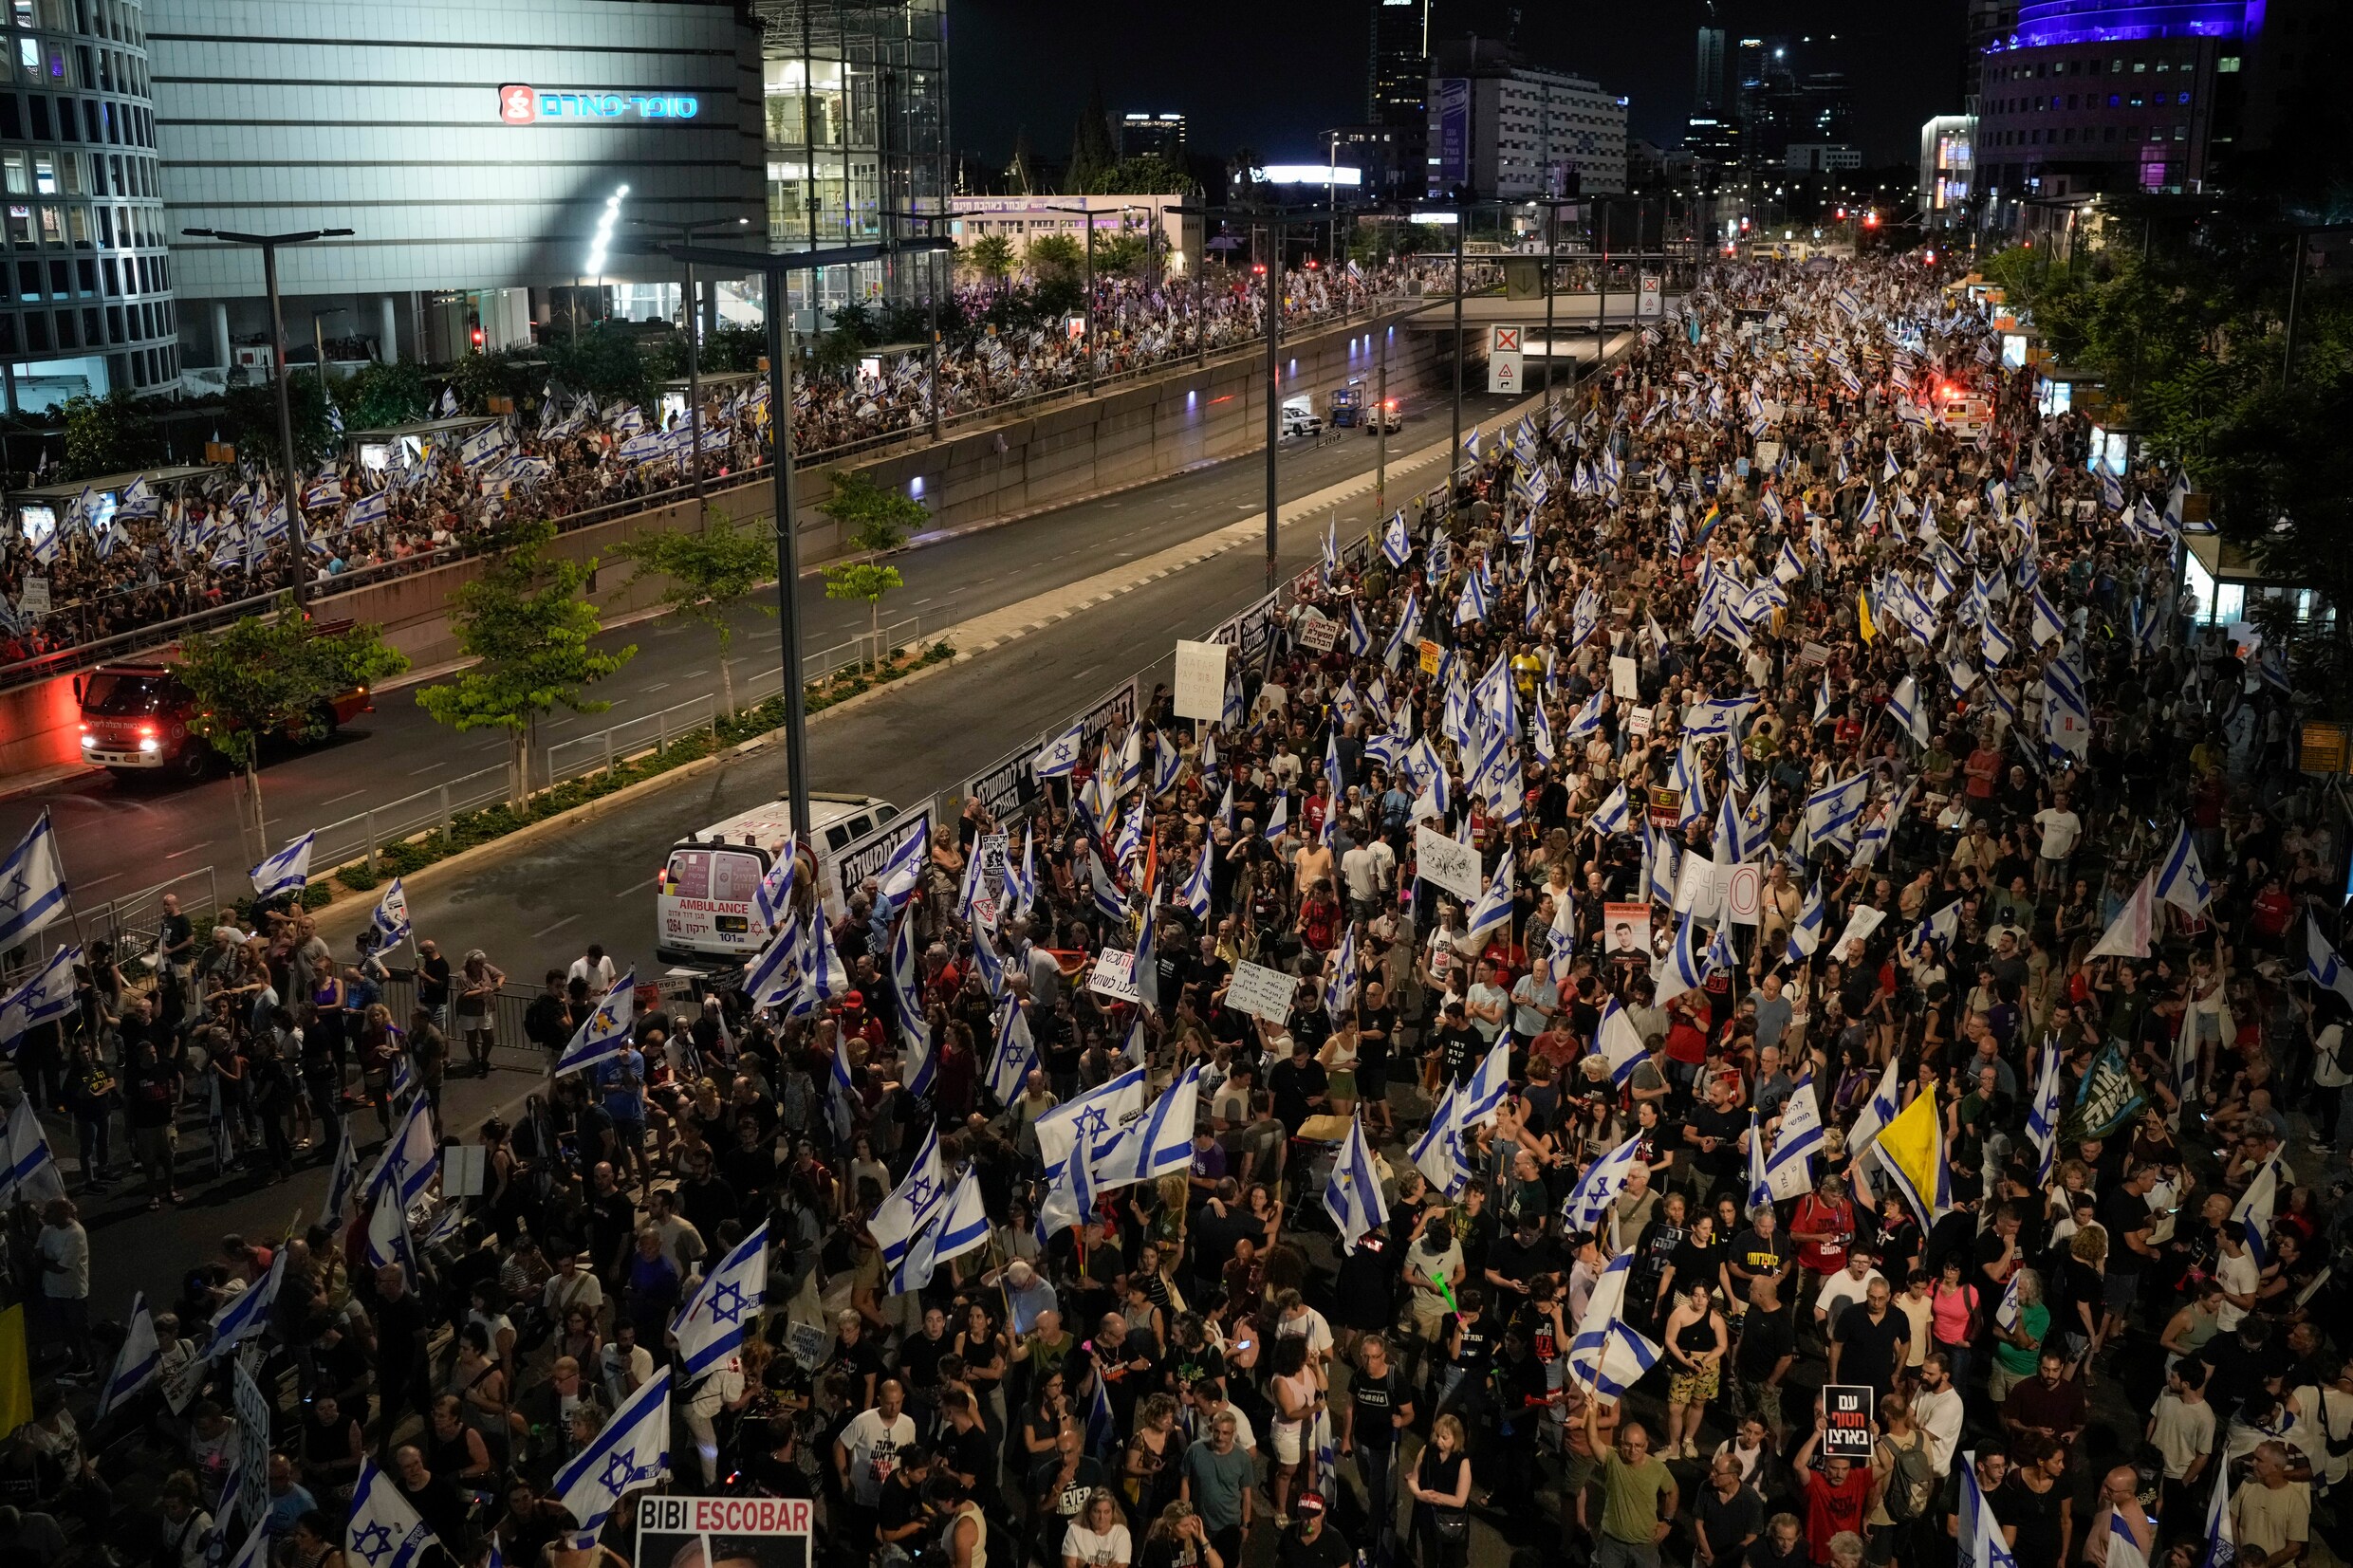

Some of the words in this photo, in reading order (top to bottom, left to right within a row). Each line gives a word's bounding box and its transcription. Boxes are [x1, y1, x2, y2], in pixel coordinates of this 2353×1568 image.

[539, 94, 698, 119] סופר-פארם
[953, 201, 973, 212] חינם
[973, 201, 1003, 211] באהבת
[1003, 201, 1028, 211] שבחר
[1306, 628, 1334, 640] ממשלת
[1303, 635, 1331, 649] הבלהות
[1182, 657, 1214, 671] QATAR
[1180, 682, 1191, 692] TO
[1193, 685, 1206, 694] SIT
[1210, 687, 1222, 697] ON
[1632, 715, 1650, 724] עסקה
[732, 872, 756, 882] מציל
[732, 883, 756, 892] חיים
[679, 898, 749, 914] AMBULANCE
[666, 919, 682, 933] 1264
[686, 923, 709, 935] ירקון
[718, 932, 737, 943] 101
[1100, 950, 1124, 967] עכשיו
[1091, 972, 1116, 988] לשווא
[1788, 1111, 1811, 1127] חופשי
[791, 1333, 815, 1348] BRING
[798, 1344, 819, 1356] THEM
[1359, 1393, 1386, 1405] oasis
[1838, 1394, 1858, 1411] עם
[1831, 1411, 1864, 1428] חטוף
[1827, 1428, 1869, 1446] בארצו
[875, 1440, 897, 1451] אתה
[640, 1499, 688, 1530] BIBI
[695, 1502, 808, 1532] ESCOBAR
